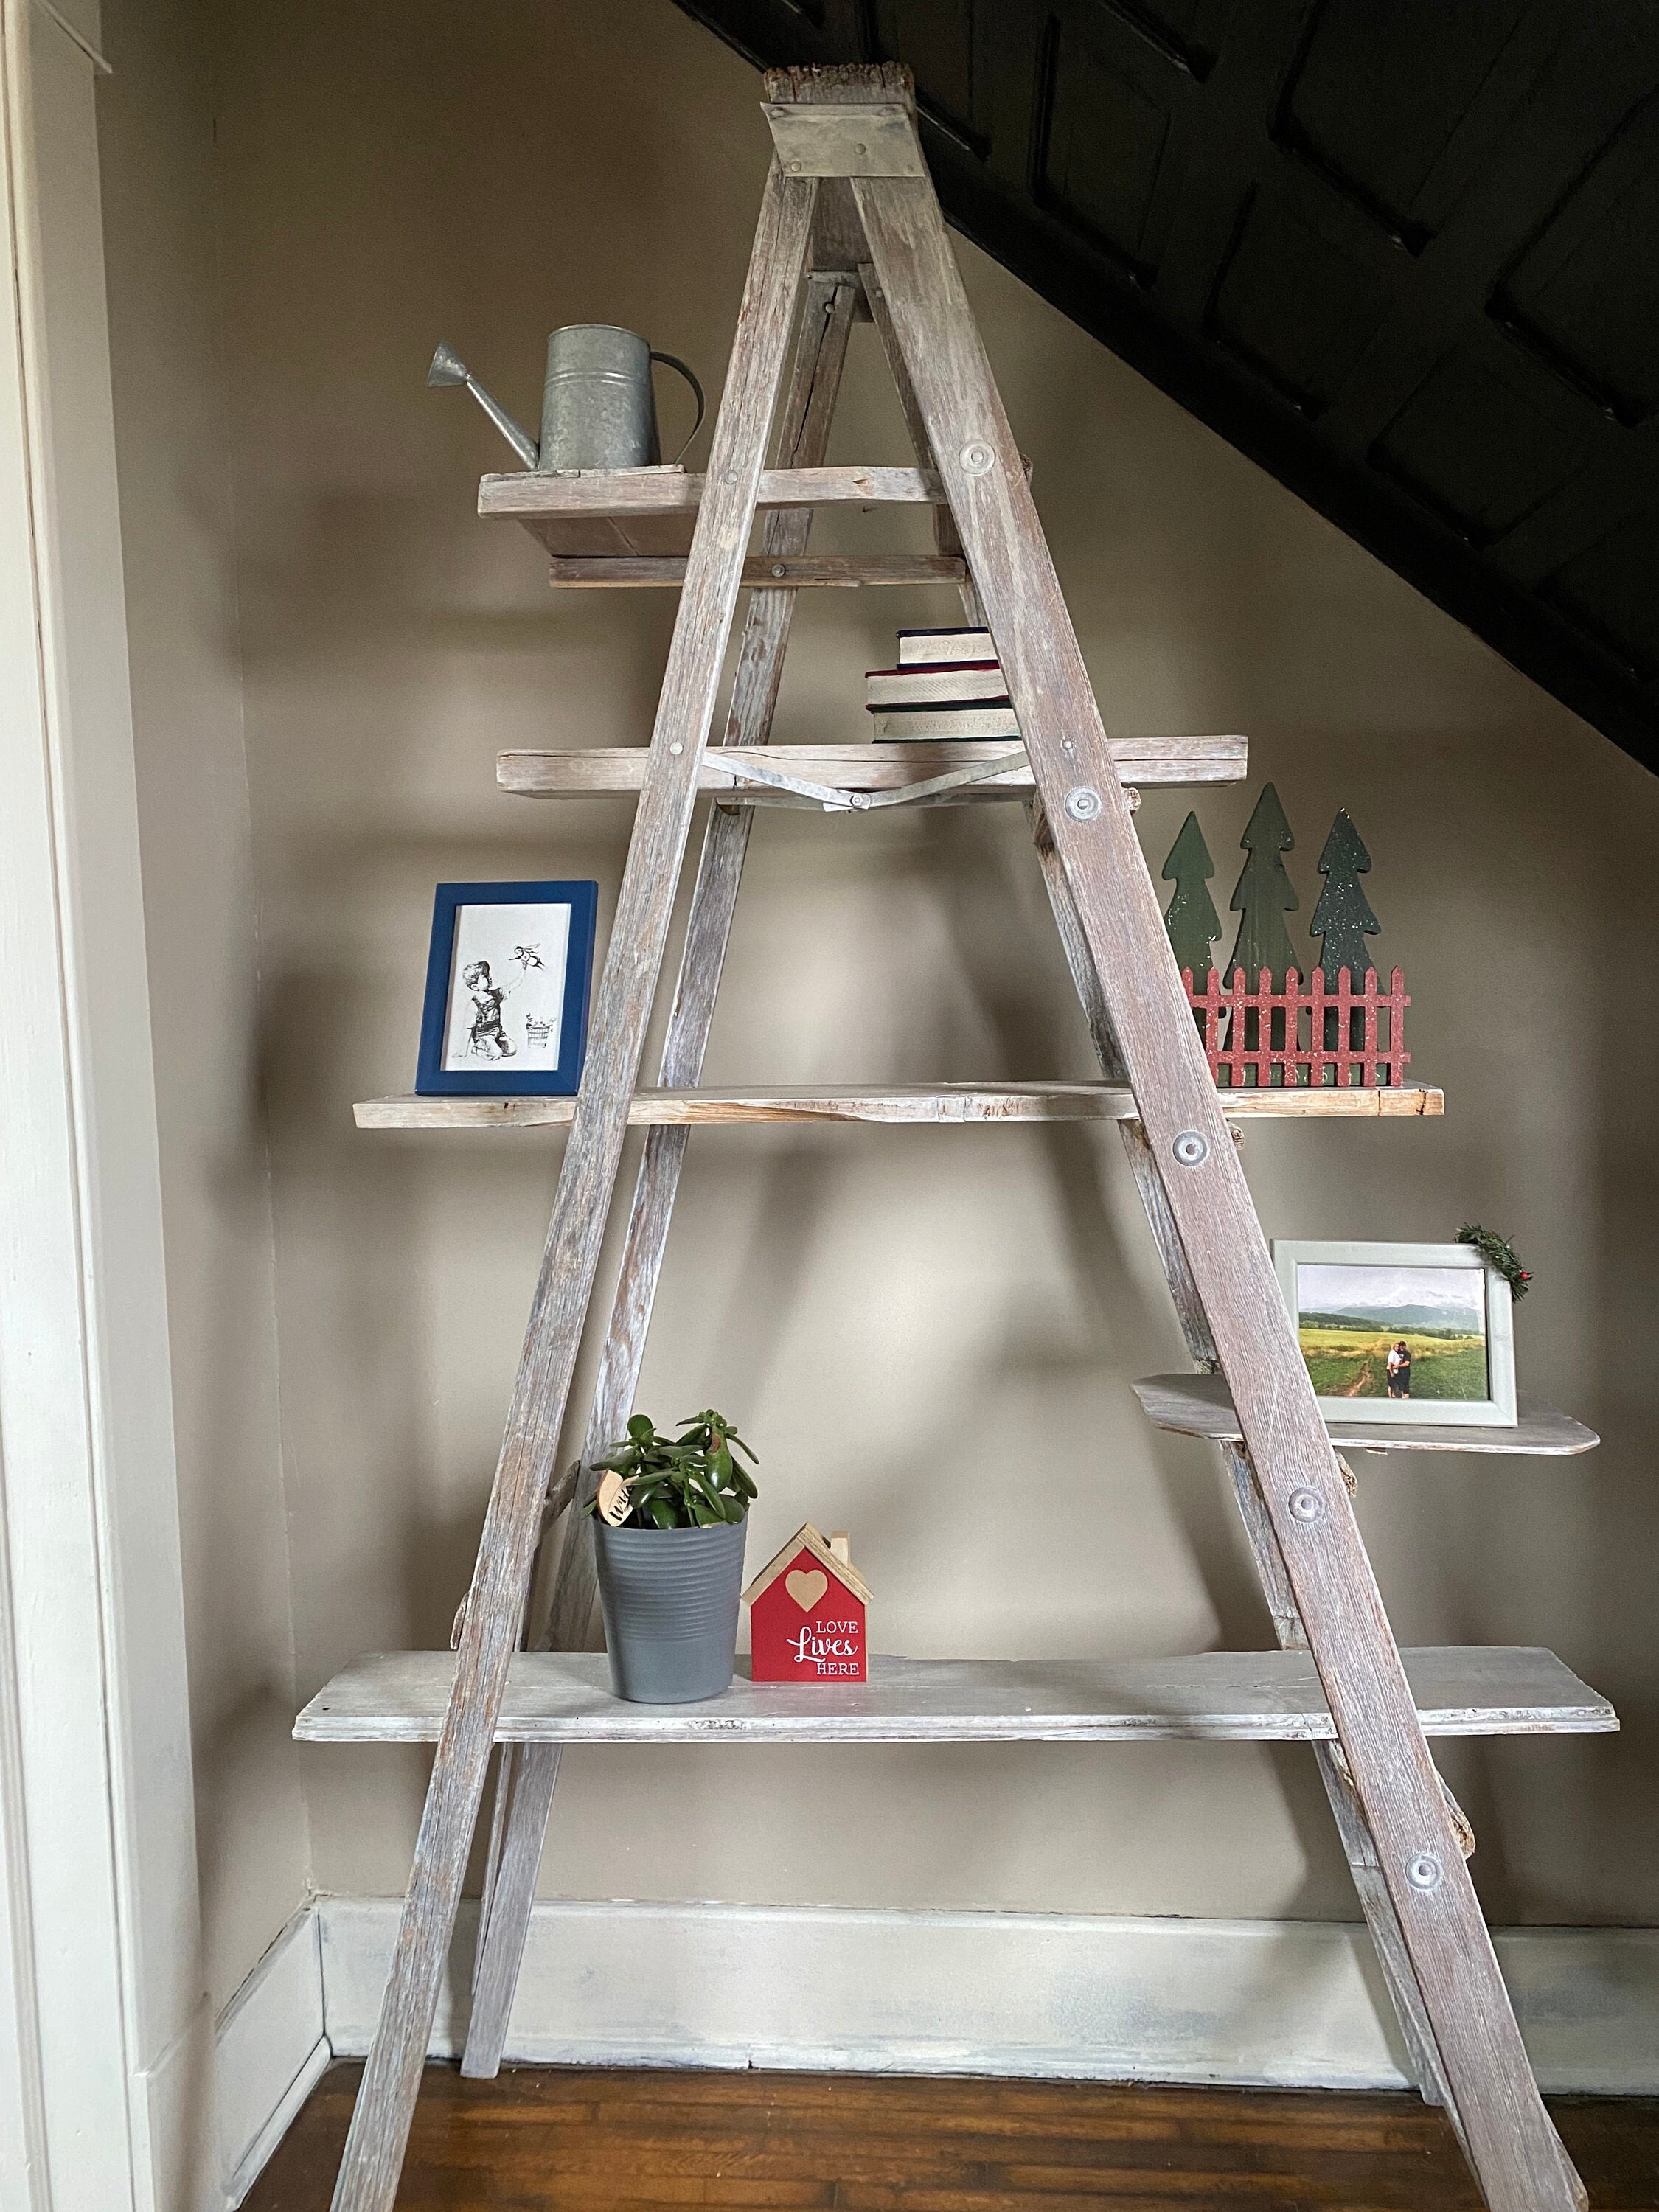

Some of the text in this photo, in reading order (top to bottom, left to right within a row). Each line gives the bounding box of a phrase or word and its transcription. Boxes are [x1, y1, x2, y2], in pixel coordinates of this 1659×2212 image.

[816, 1621, 858, 1634] LOVE
[786, 1626, 858, 1663] Lives
[816, 1663, 860, 1675] HERE
